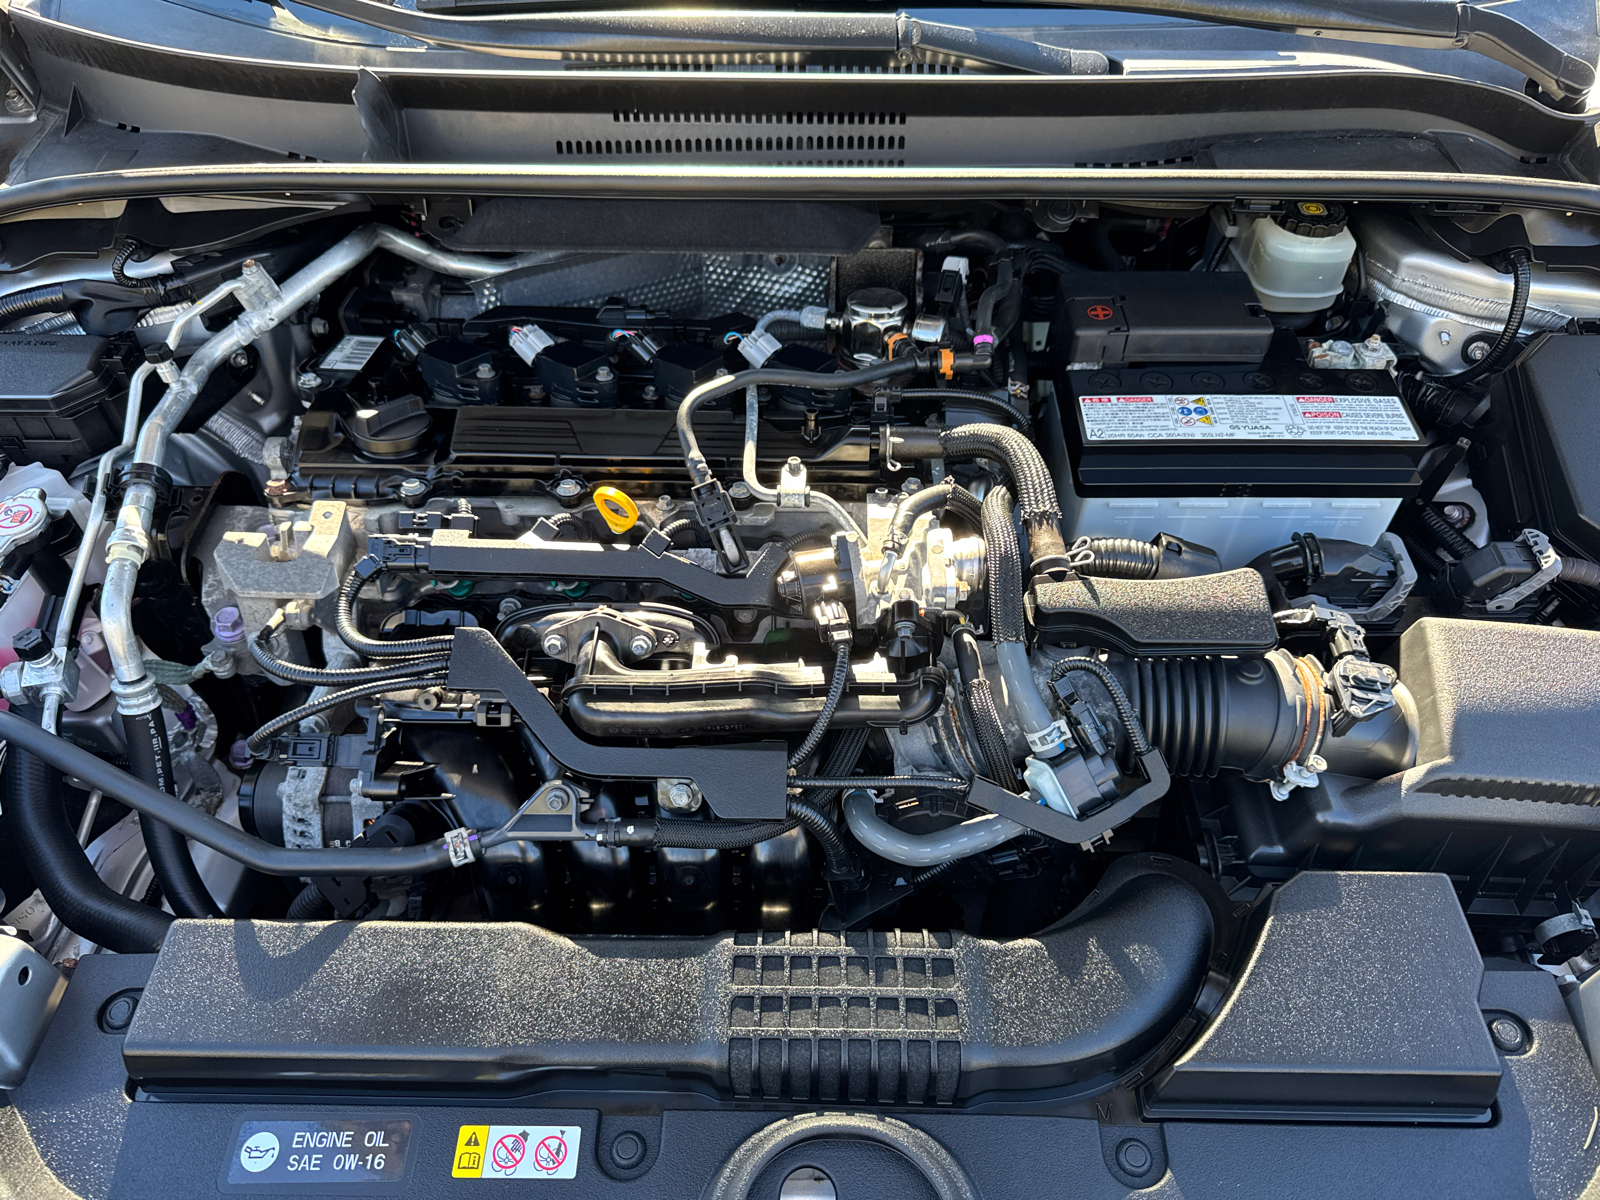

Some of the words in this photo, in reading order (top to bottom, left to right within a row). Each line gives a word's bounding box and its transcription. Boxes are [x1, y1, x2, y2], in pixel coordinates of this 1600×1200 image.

[1089, 428, 1105, 438] A2
[292, 1131, 354, 1148] ENGINE
[364, 1131, 390, 1147] OIL
[287, 1154, 323, 1171] SAE
[332, 1153, 386, 1171] 0W-16
